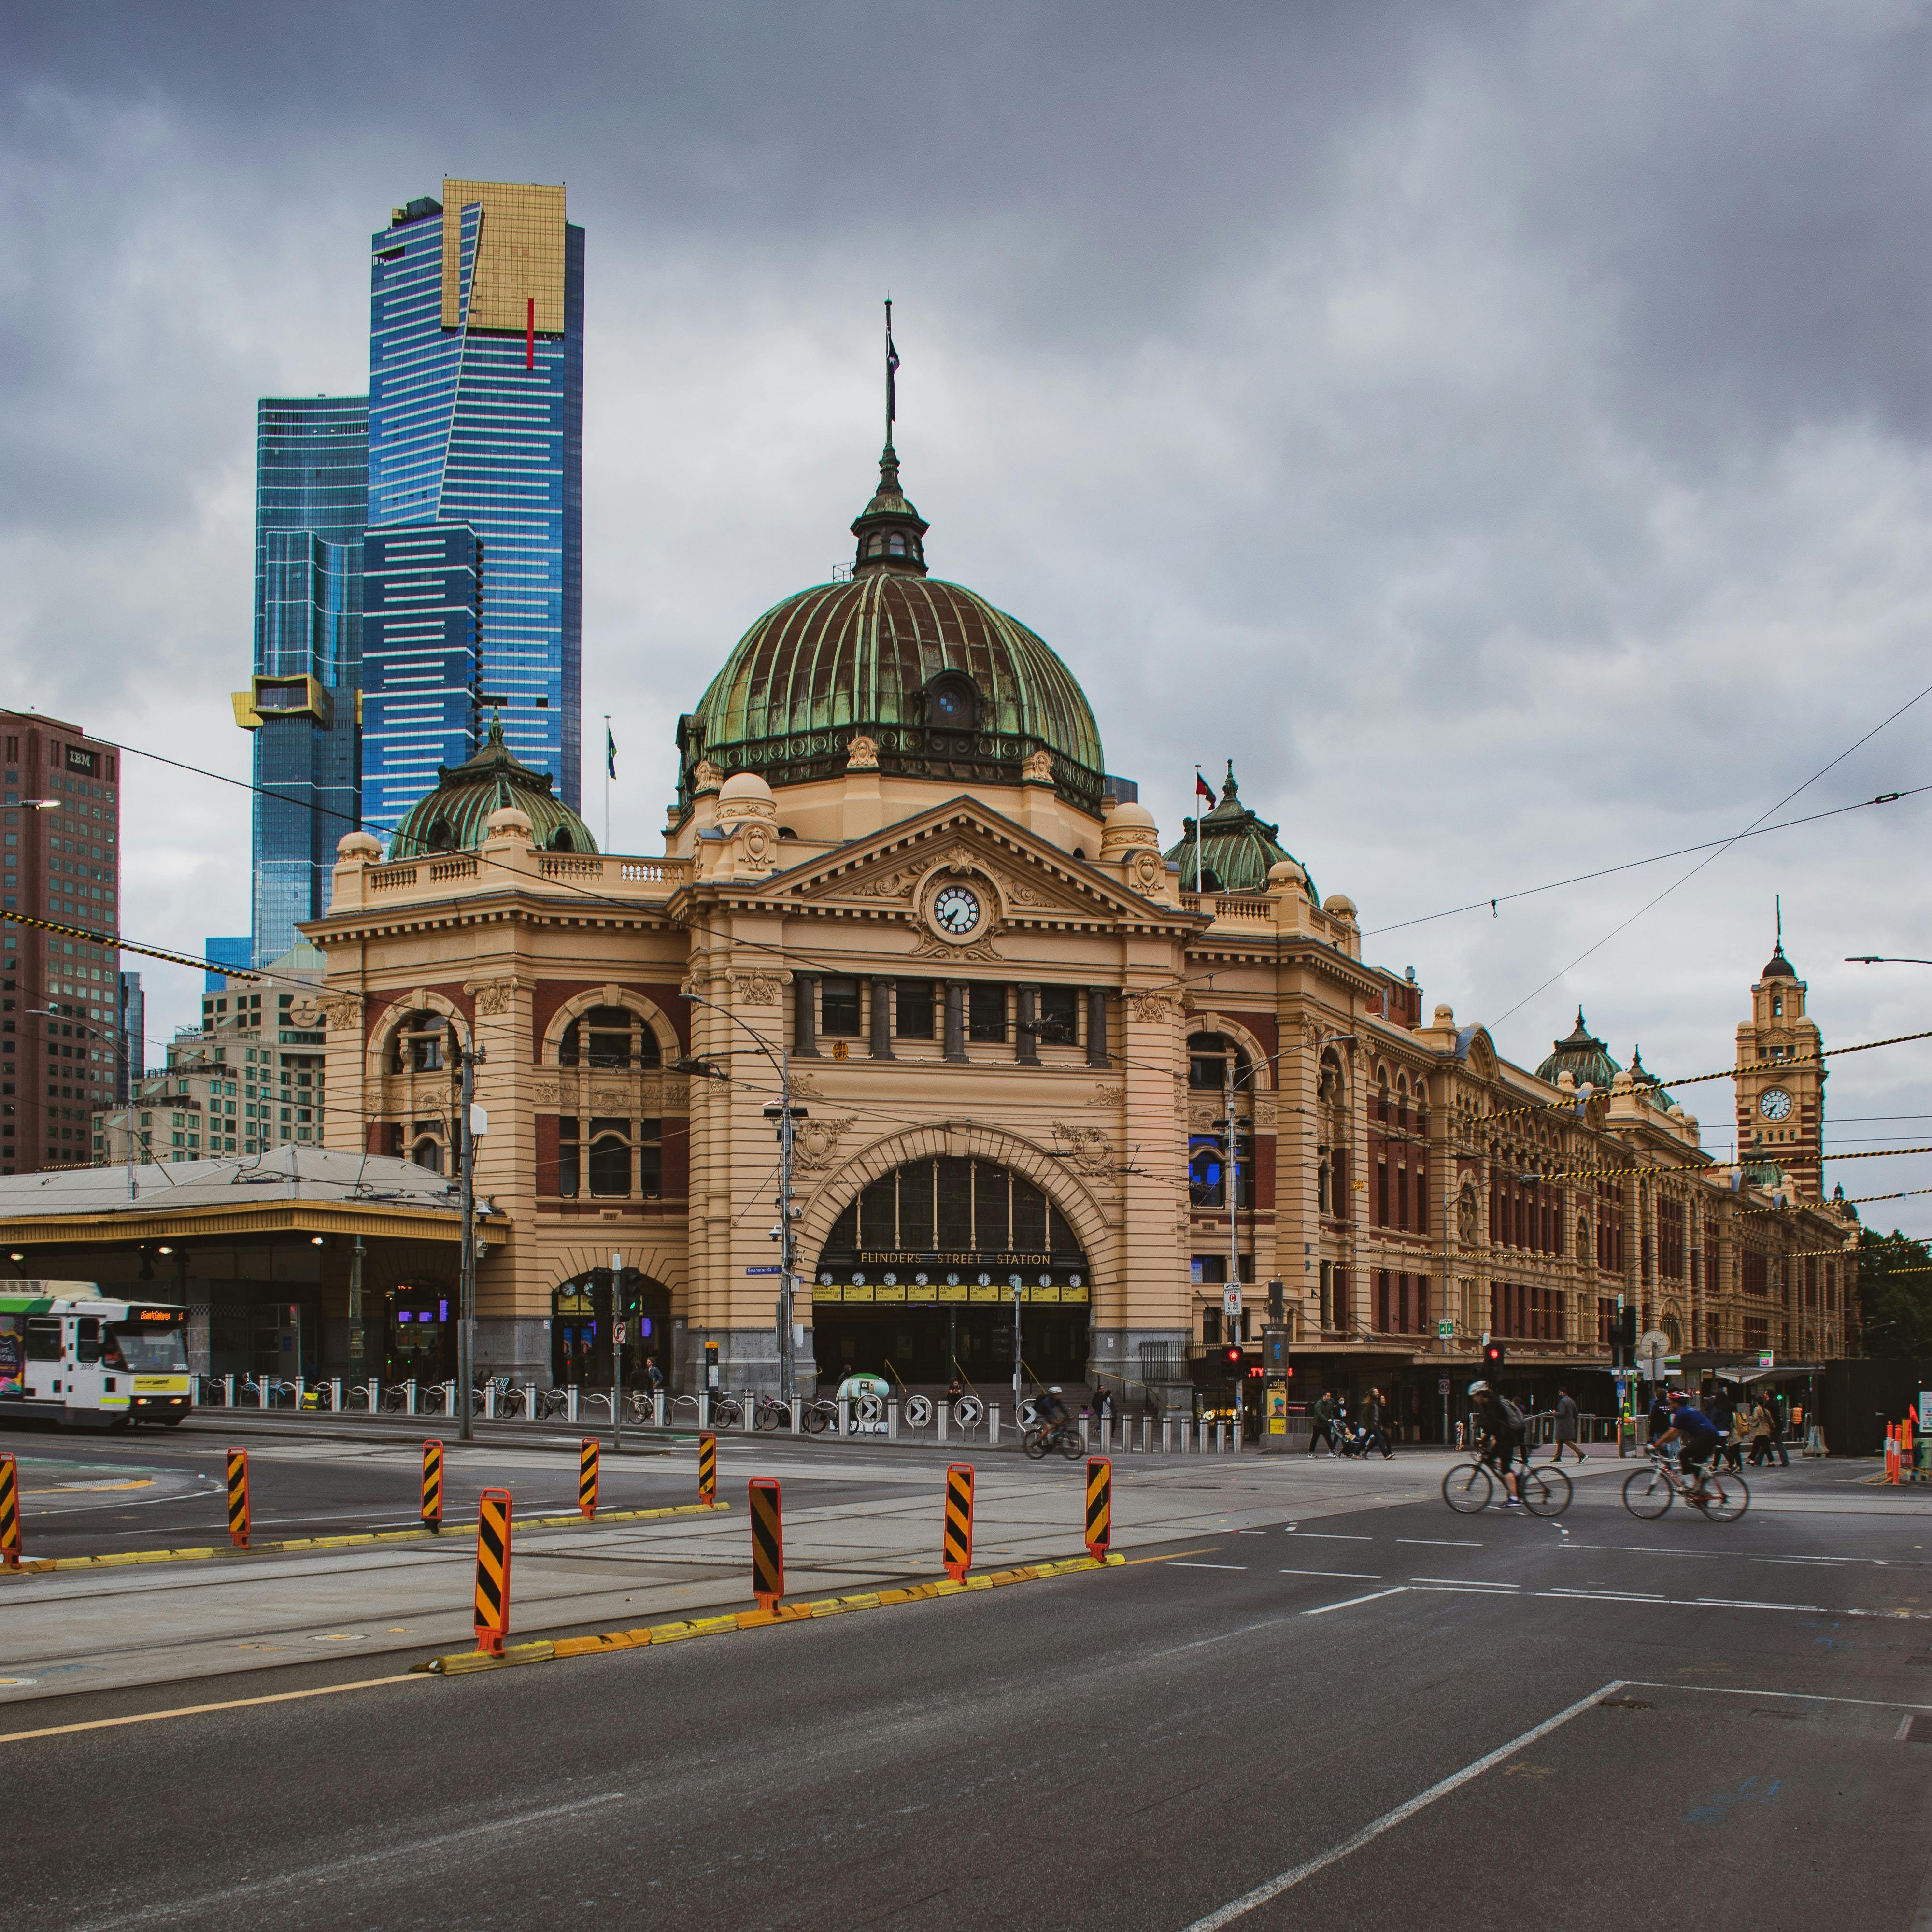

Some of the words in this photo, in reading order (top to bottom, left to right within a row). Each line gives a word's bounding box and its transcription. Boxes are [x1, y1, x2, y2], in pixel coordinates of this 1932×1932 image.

[70, 750, 91, 767] IBM
[861, 1252, 921, 1263] FLINDERS
[937, 1253, 982, 1264] STREET
[996, 1254, 1050, 1265] STATION
